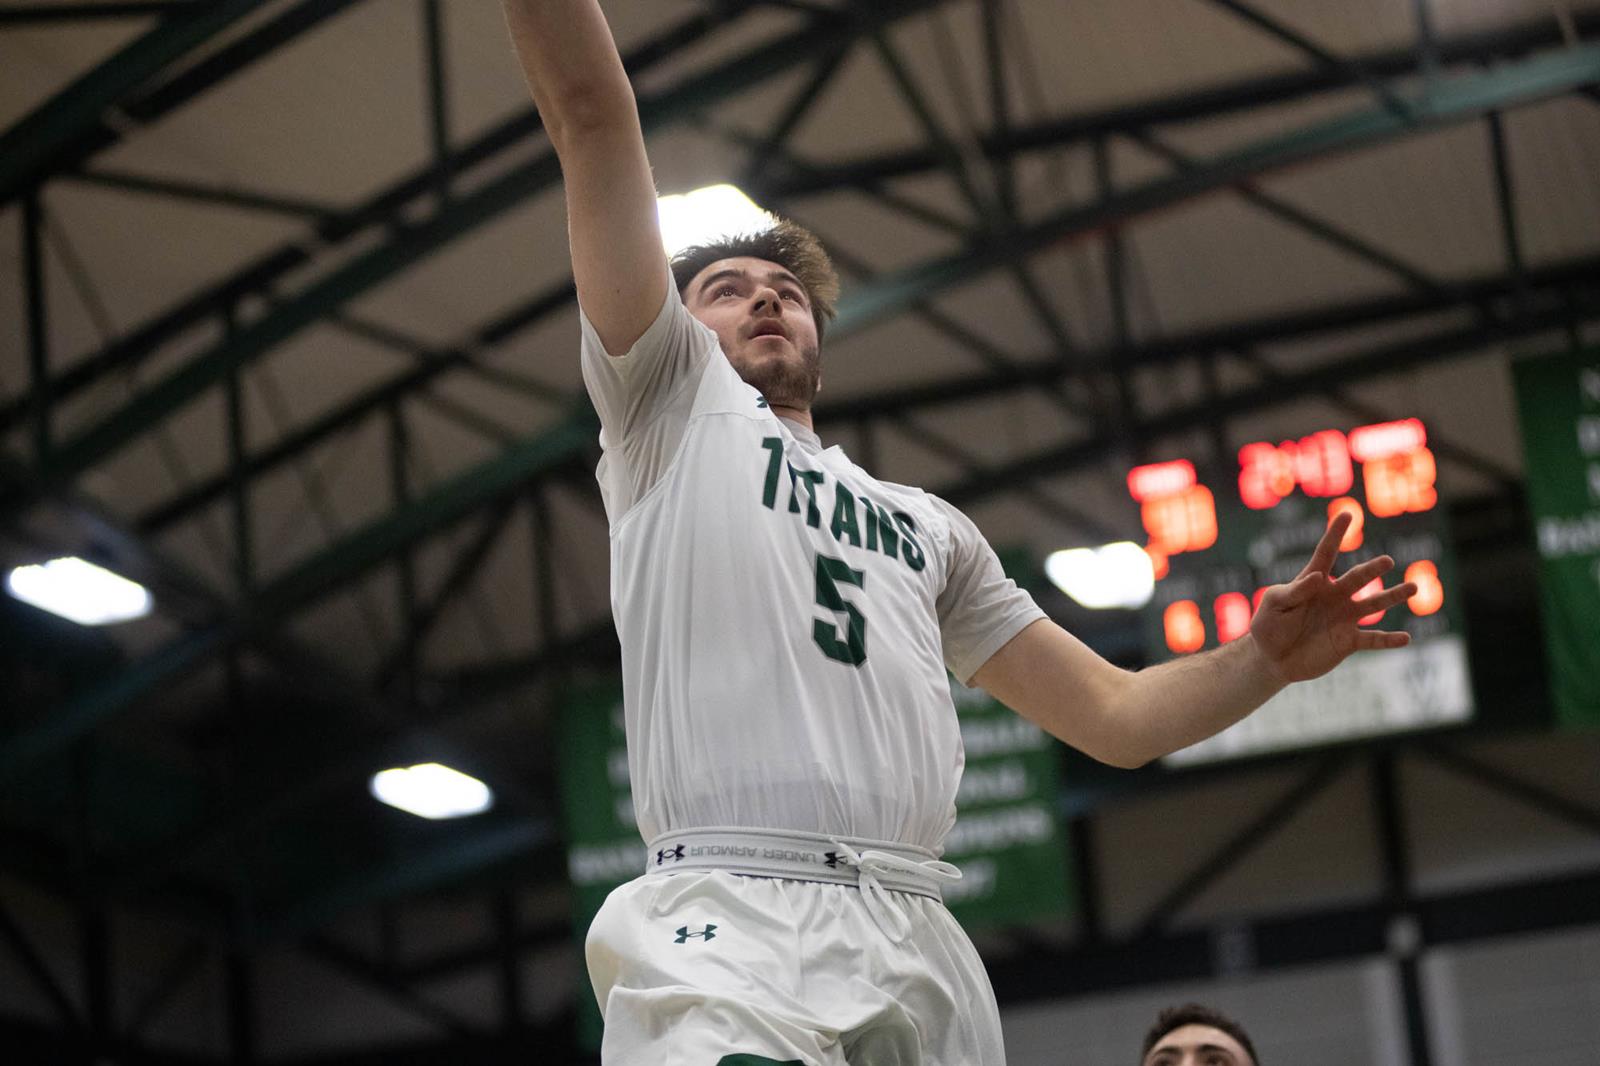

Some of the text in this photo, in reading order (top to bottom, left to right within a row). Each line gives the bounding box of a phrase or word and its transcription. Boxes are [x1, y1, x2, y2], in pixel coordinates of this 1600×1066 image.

[761, 437, 926, 572] TITANS
[812, 552, 867, 668] 5
[690, 844, 817, 863] UNDER ARMOUR
